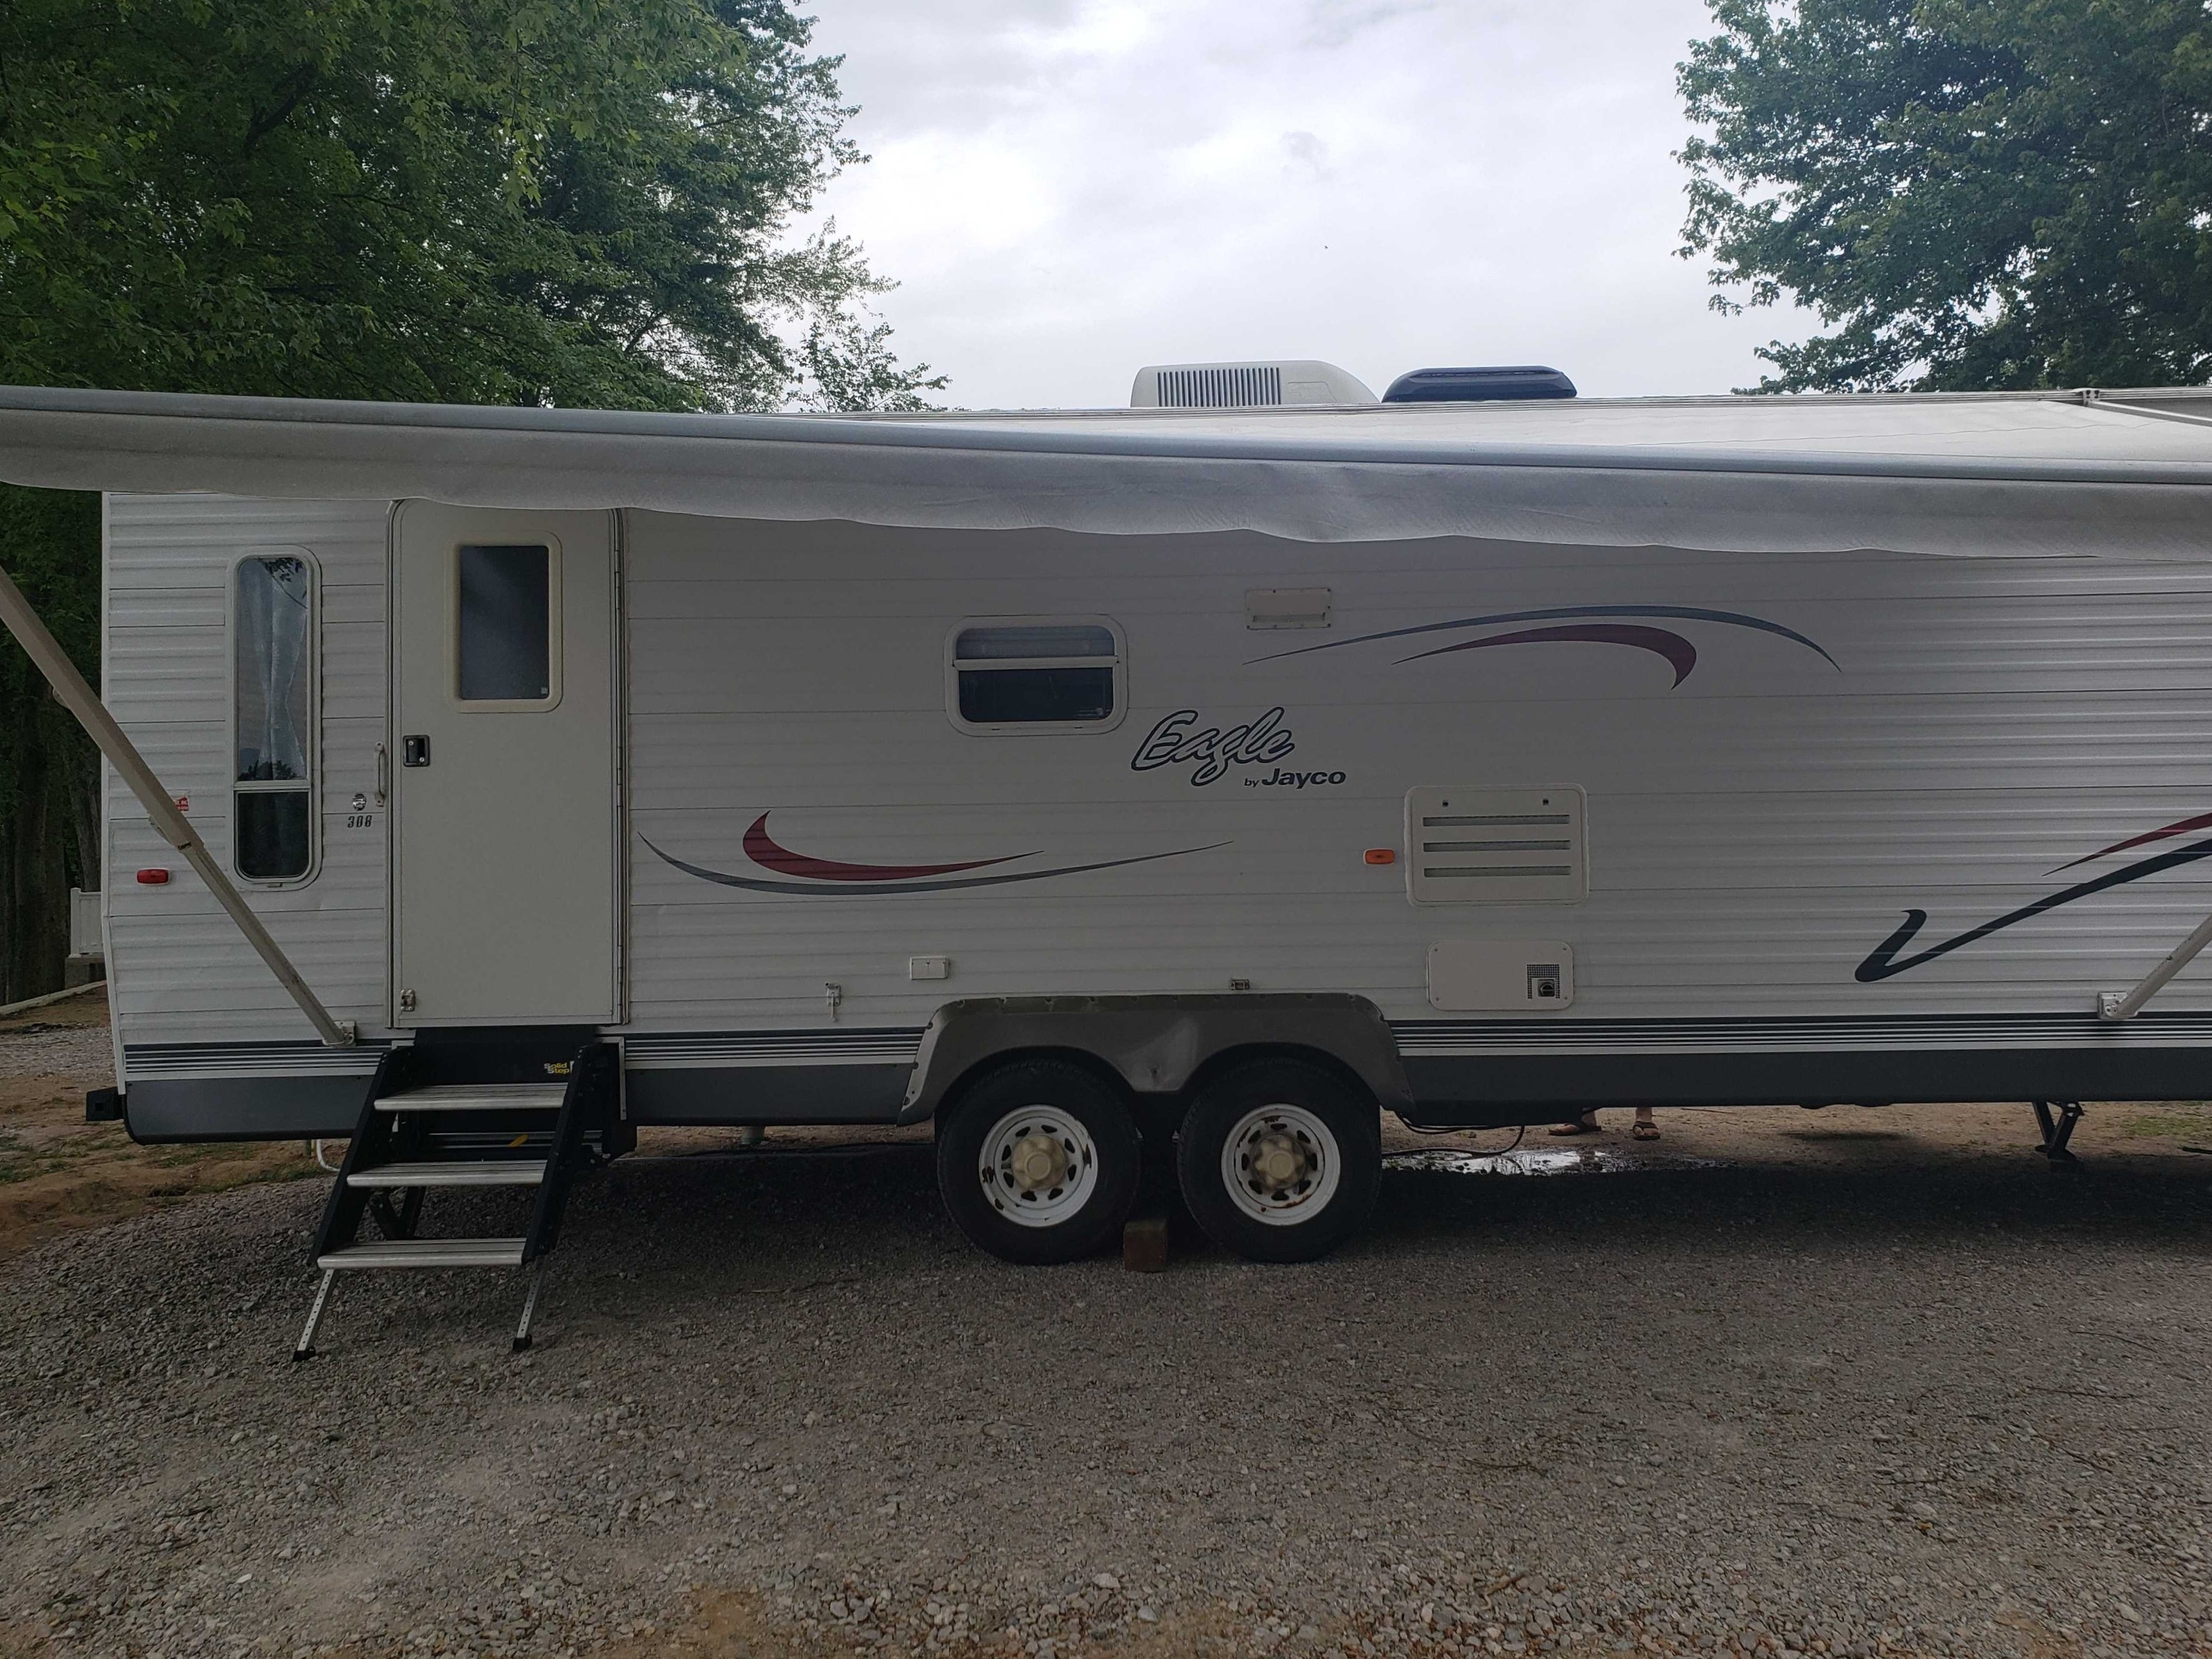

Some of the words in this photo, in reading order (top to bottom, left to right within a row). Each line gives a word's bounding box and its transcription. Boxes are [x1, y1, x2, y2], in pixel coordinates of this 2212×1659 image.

[1131, 706, 1295, 787] Eagle
[1244, 778, 1259, 788] by
[1261, 768, 1346, 789] Jayco
[347, 815, 372, 828] 308
